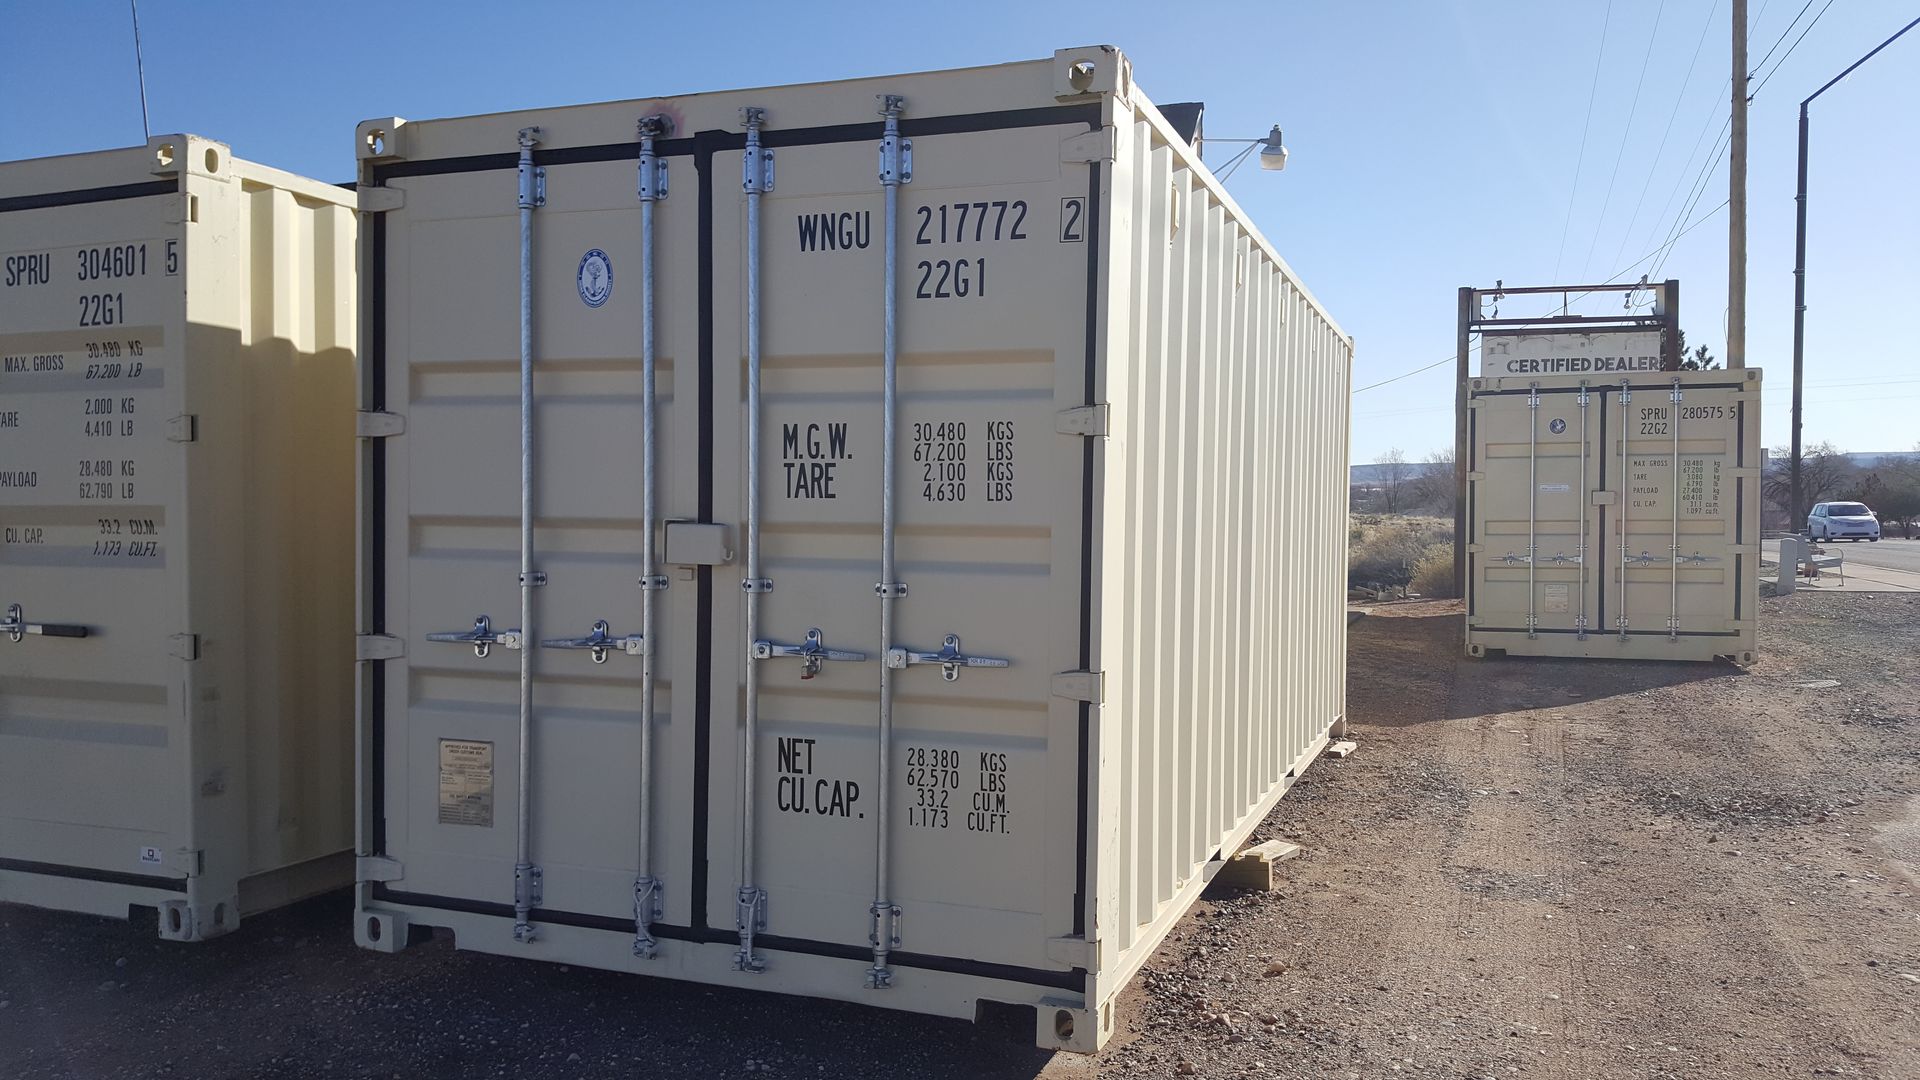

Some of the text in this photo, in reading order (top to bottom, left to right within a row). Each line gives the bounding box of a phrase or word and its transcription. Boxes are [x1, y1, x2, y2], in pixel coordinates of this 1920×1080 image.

[798, 200, 1082, 252] WNGU 217772 2
[6, 241, 178, 287] SPRU 304601 5
[916, 258, 985, 299] 22G1
[79, 292, 124, 327] 22G1
[128, 340, 143, 357] KG
[4, 355, 64, 373] MAX. GROSS
[128, 362, 143, 378] LB
[1507, 356, 1660, 374] CERTIFIED DEALER
[121, 397, 135, 414] KG
[1640, 406, 1736, 420] SPRU 280575 5
[0, 411, 19, 428] ARE
[121, 420, 134, 436] LB
[1640, 422, 1668, 435] 22G2
[783, 422, 853, 459] M.G.W.
[913, 421, 1014, 442] 30,480 KGS
[913, 442, 1013, 462] 67,200 LBS
[121, 460, 135, 476] KG
[923, 462, 1014, 482] 2,100 KGS
[121, 482, 134, 499] LB
[783, 462, 836, 499] TARE
[922, 482, 1013, 502] 4,630 LBS
[5, 527, 44, 544] CU. CAP.
[99, 519, 158, 536] 33.2 CU.M.
[128, 540, 158, 557] CU.FT.
[778, 737, 815, 774] NET
[907, 748, 1007, 772] 28,380 KGS
[907, 768, 1006, 793] 62,570 LBS
[917, 788, 1010, 814] 33.2 CU.M.
[908, 807, 1010, 835] 1,173 CU.FT.
